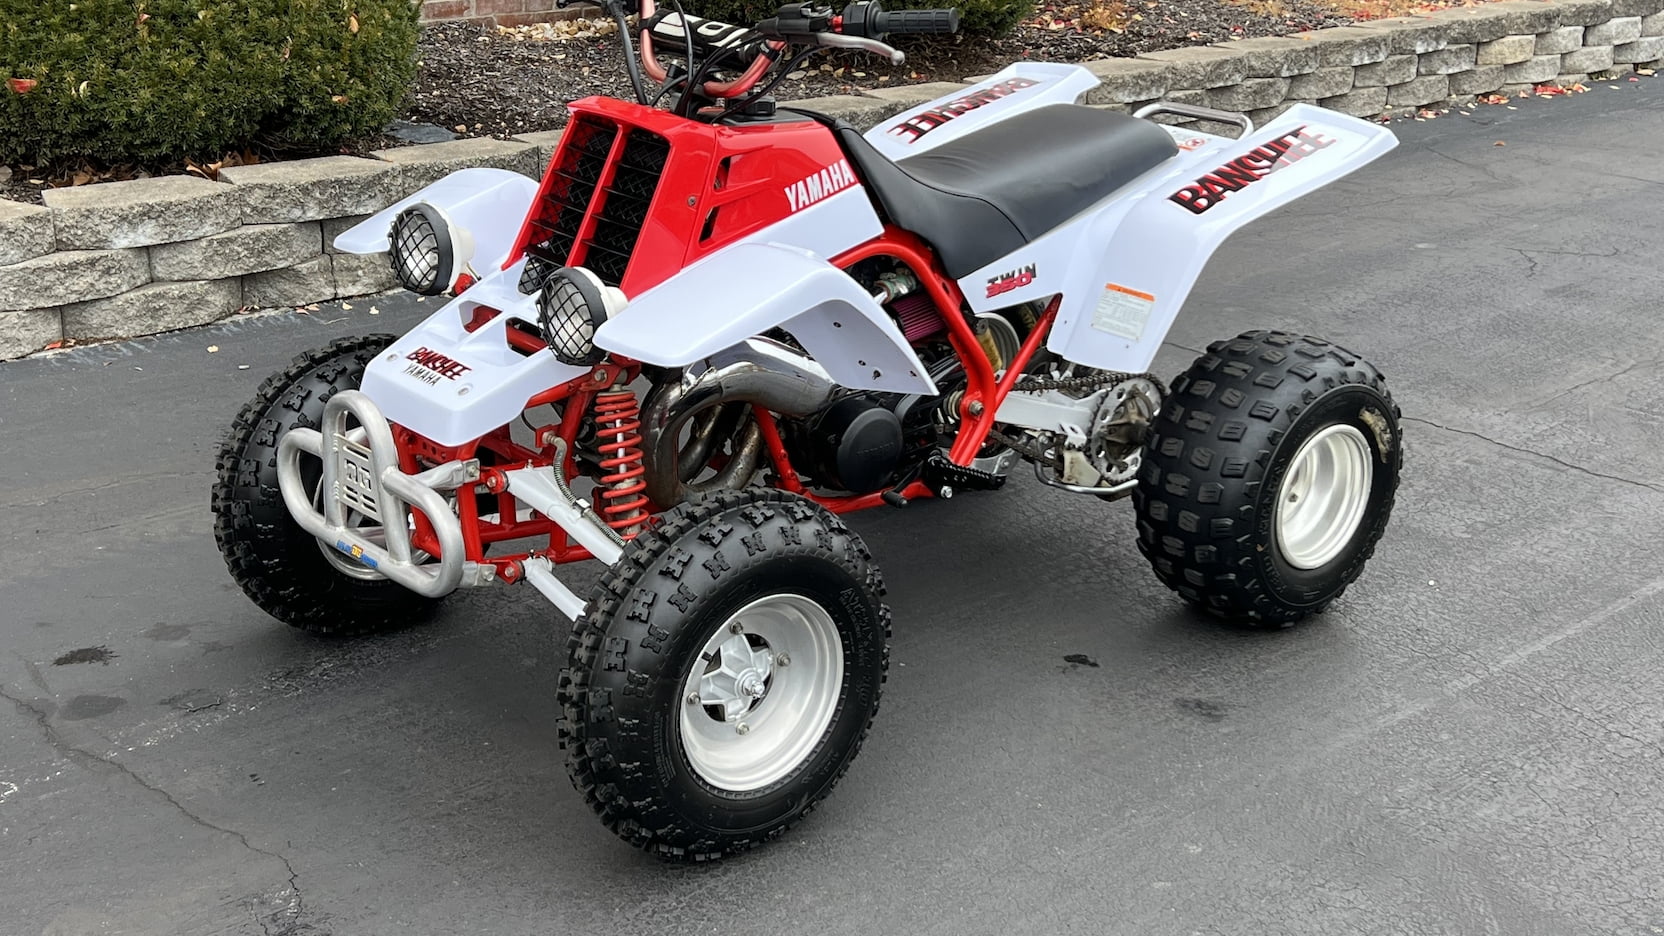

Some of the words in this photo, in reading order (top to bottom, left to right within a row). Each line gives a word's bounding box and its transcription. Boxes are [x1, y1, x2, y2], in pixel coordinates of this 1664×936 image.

[784, 158, 856, 213] YAMAHA
[1166, 125, 1337, 215] BANSHEE
[986, 271, 1032, 299] 350
[987, 262, 1037, 284] TWIN
[403, 363, 442, 386] YAMAHA
[405, 346, 472, 381] BANSHEE
